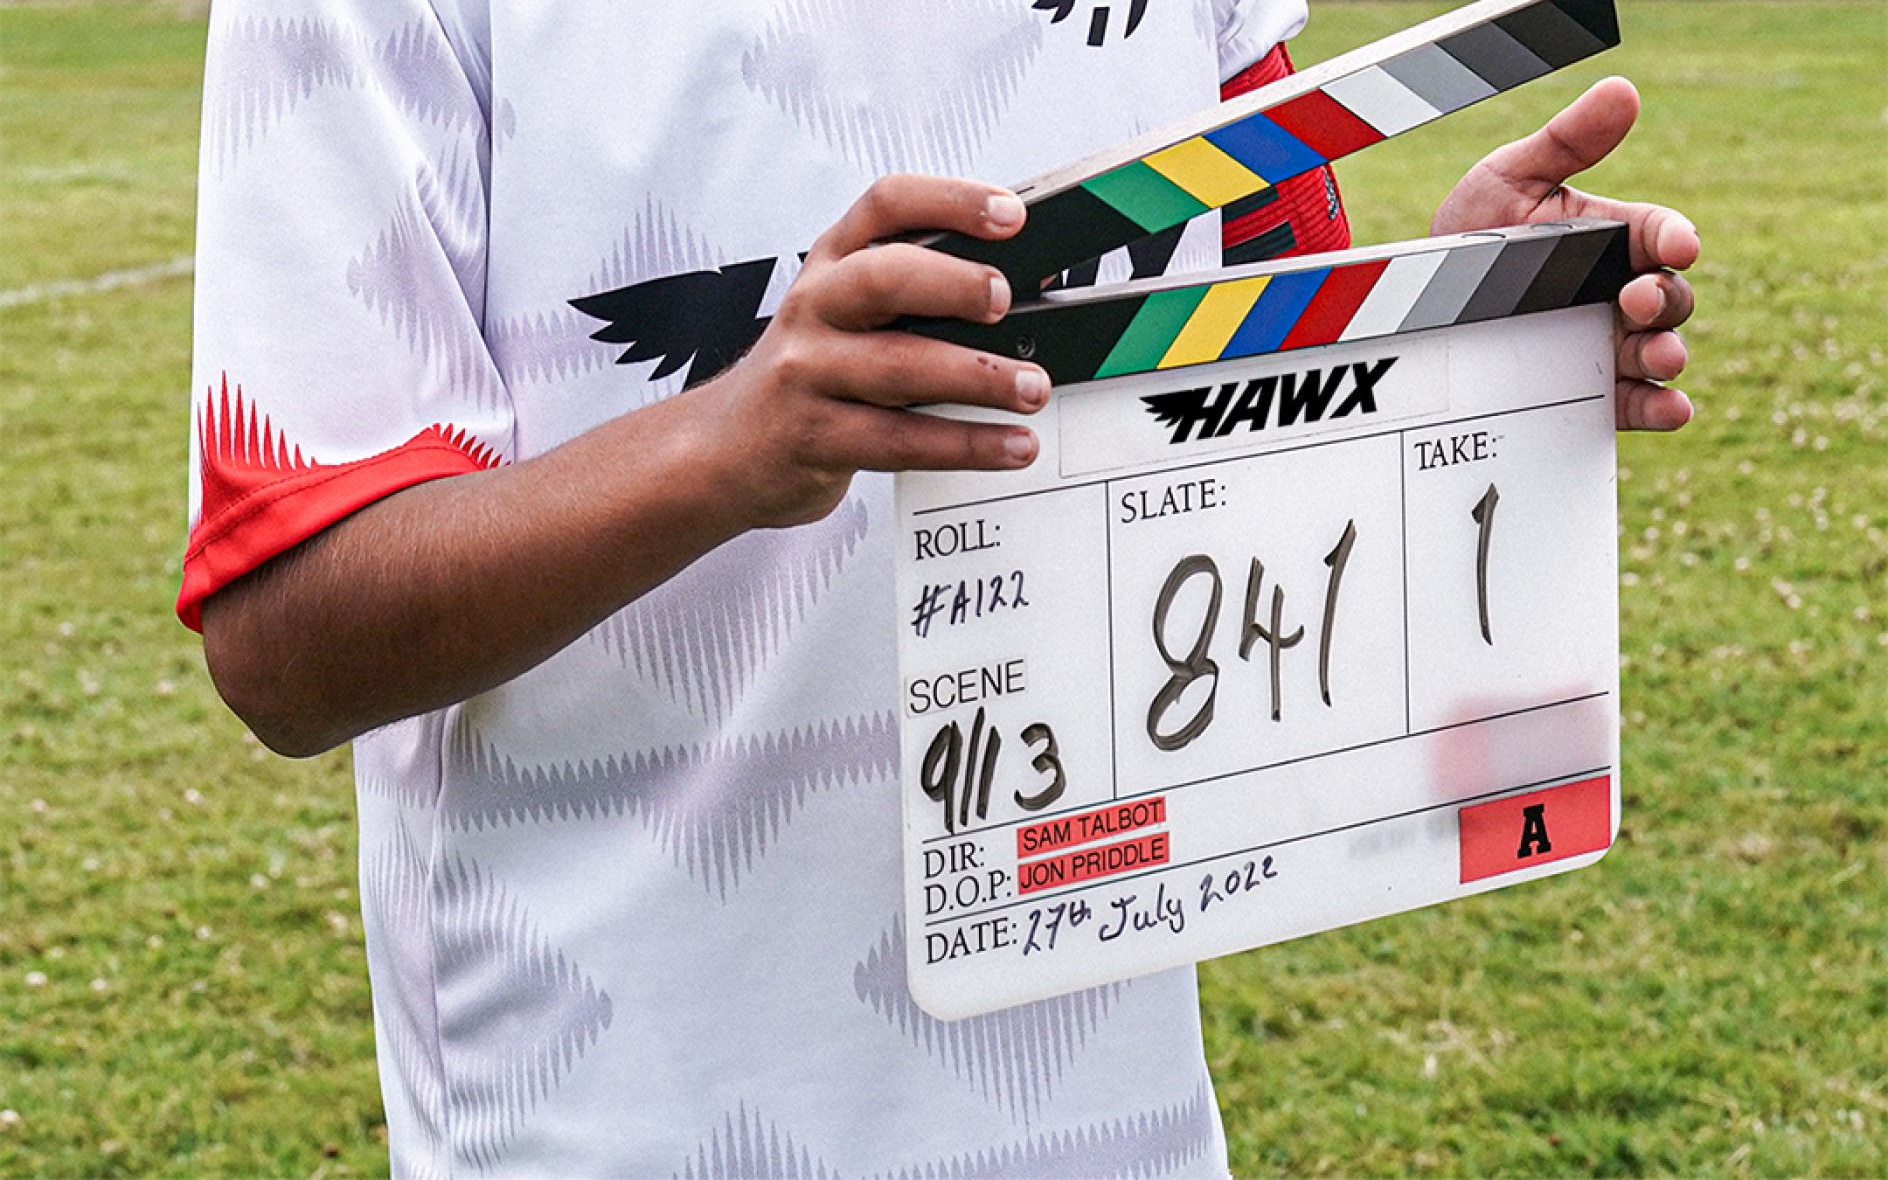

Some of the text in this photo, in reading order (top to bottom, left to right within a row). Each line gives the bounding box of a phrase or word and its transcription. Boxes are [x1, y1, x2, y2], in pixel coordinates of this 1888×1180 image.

[1150, 356, 1399, 445] HAWX
[1413, 431, 1497, 471] TAKE:
[1121, 479, 1227, 523] SLATE:
[913, 519, 1001, 561] ROLL:
[1471, 481, 1500, 646] 1
[911, 570, 1030, 638] #A122
[1146, 518, 1357, 752] 841
[909, 659, 1026, 713] SCENE
[1023, 799, 1162, 852] SAM TALBOT
[1517, 803, 1553, 860] A
[922, 842, 985, 880] DIR:
[1020, 837, 1165, 889] JON PRIDDLE
[924, 870, 1012, 917] D.O.P:
[1022, 854, 1279, 956] 27th July 2022
[925, 916, 1018, 966] DATE:
